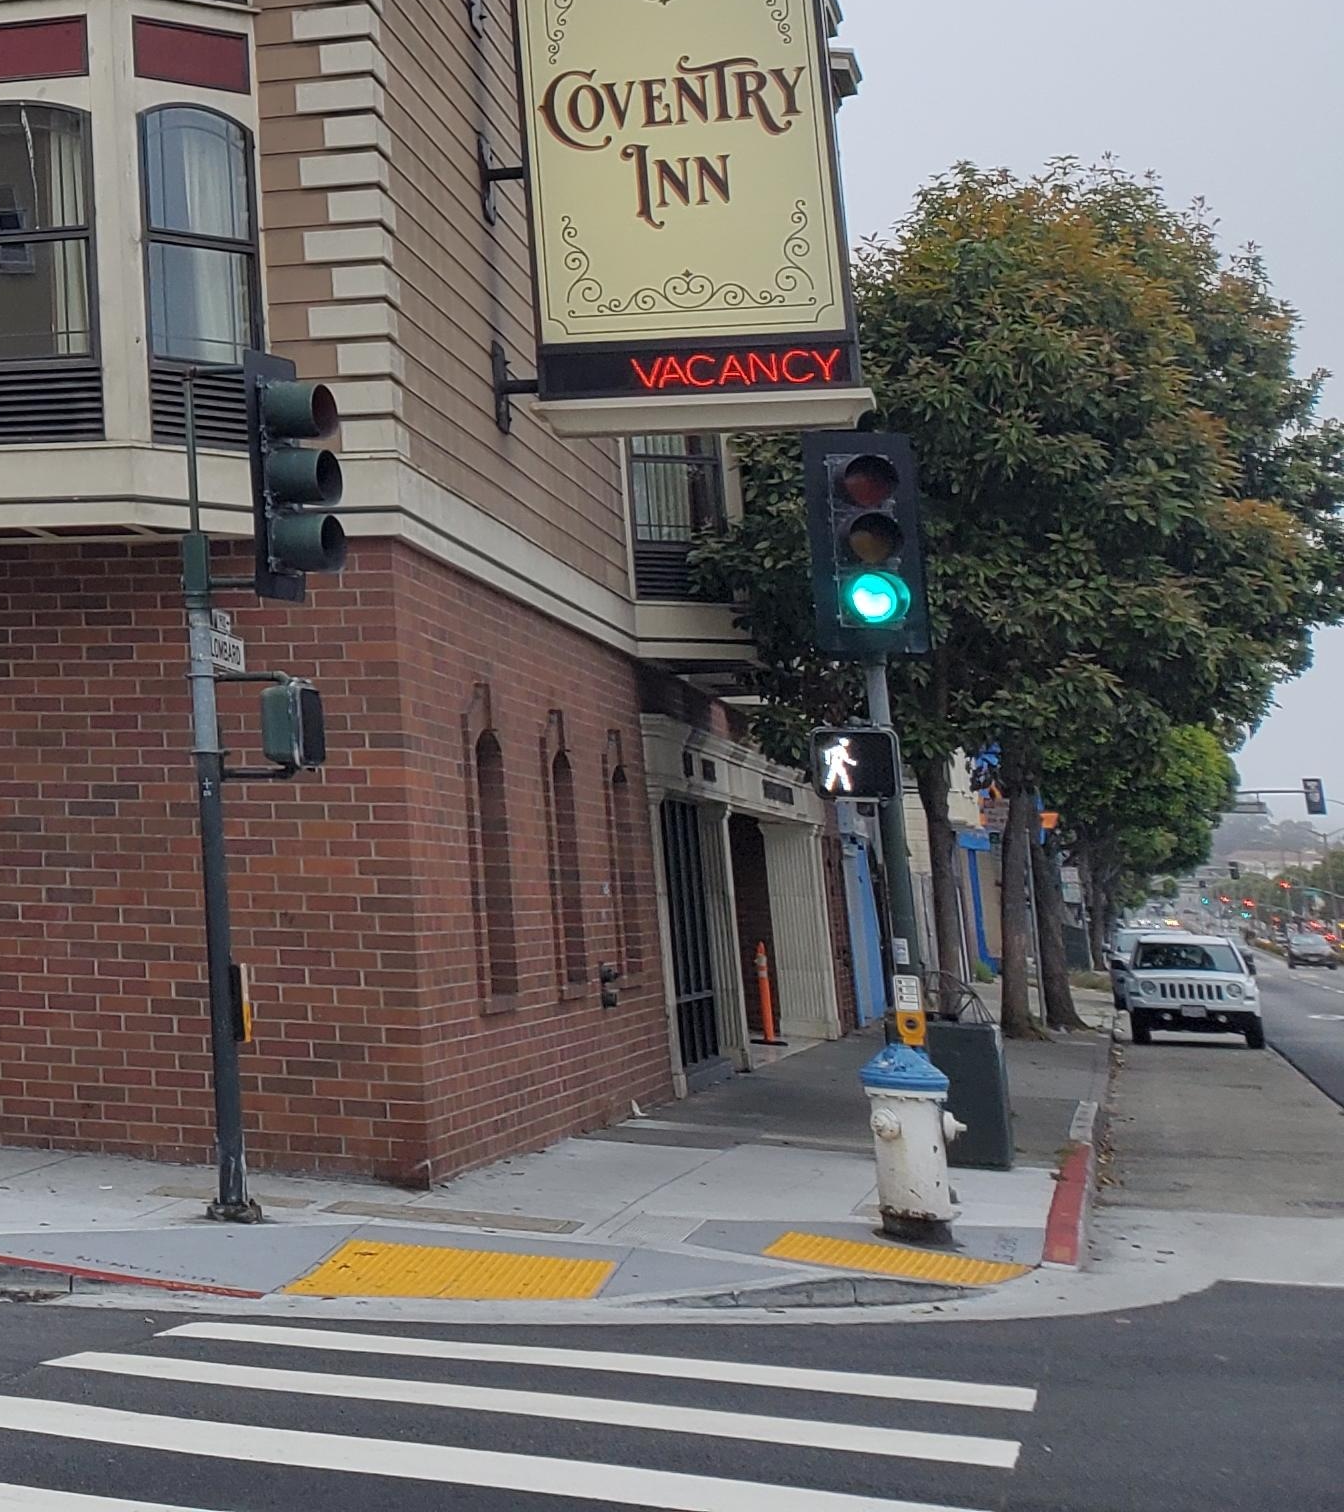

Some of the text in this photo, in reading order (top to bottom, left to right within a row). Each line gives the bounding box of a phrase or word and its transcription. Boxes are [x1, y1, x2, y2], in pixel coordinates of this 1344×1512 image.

[538, 55, 806, 151] COVENTRY
[619, 143, 732, 230] INN
[631, 347, 842, 389] VACANCY
[211, 637, 241, 666] LOMBARD
